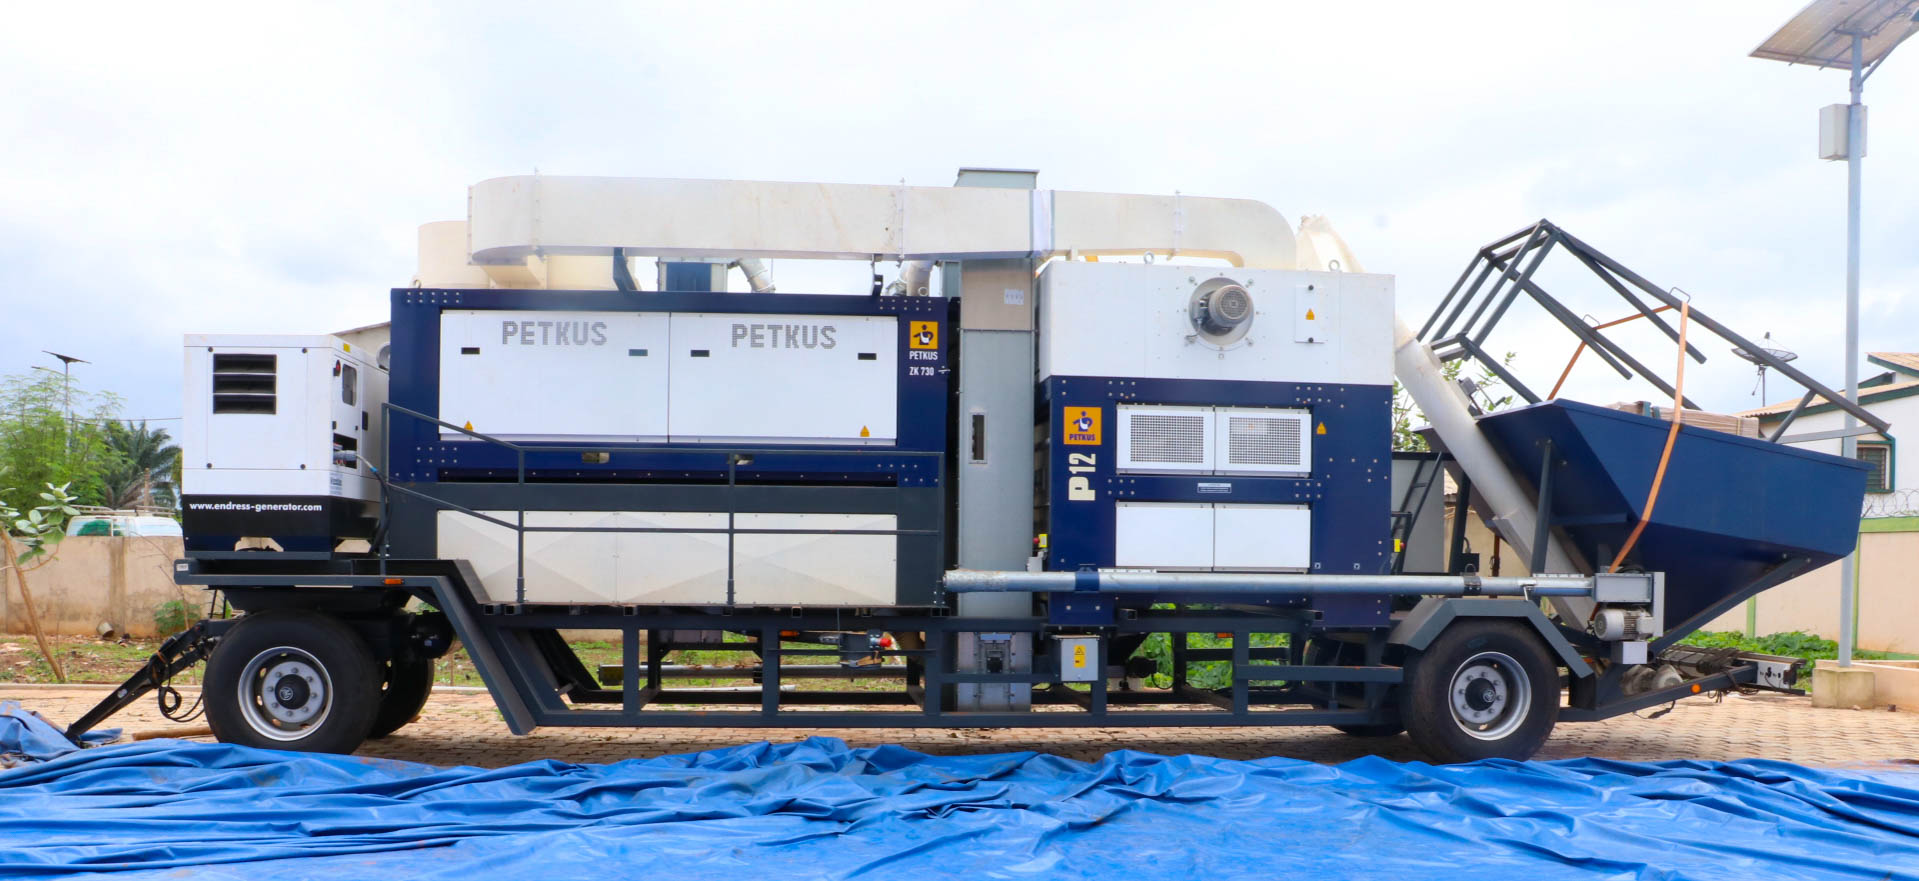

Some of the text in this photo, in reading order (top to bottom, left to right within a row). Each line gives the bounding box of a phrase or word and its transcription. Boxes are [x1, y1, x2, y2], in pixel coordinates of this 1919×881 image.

[502, 320, 607, 346] PETKUS
[731, 323, 837, 349] PETKUS
[909, 351, 938, 360] PETKUS
[909, 366, 935, 376] ZK 730
[1069, 433, 1096, 441] PETKUS
[1068, 453, 1096, 501] P12
[189, 501, 323, 512] www.endress-generator.com
